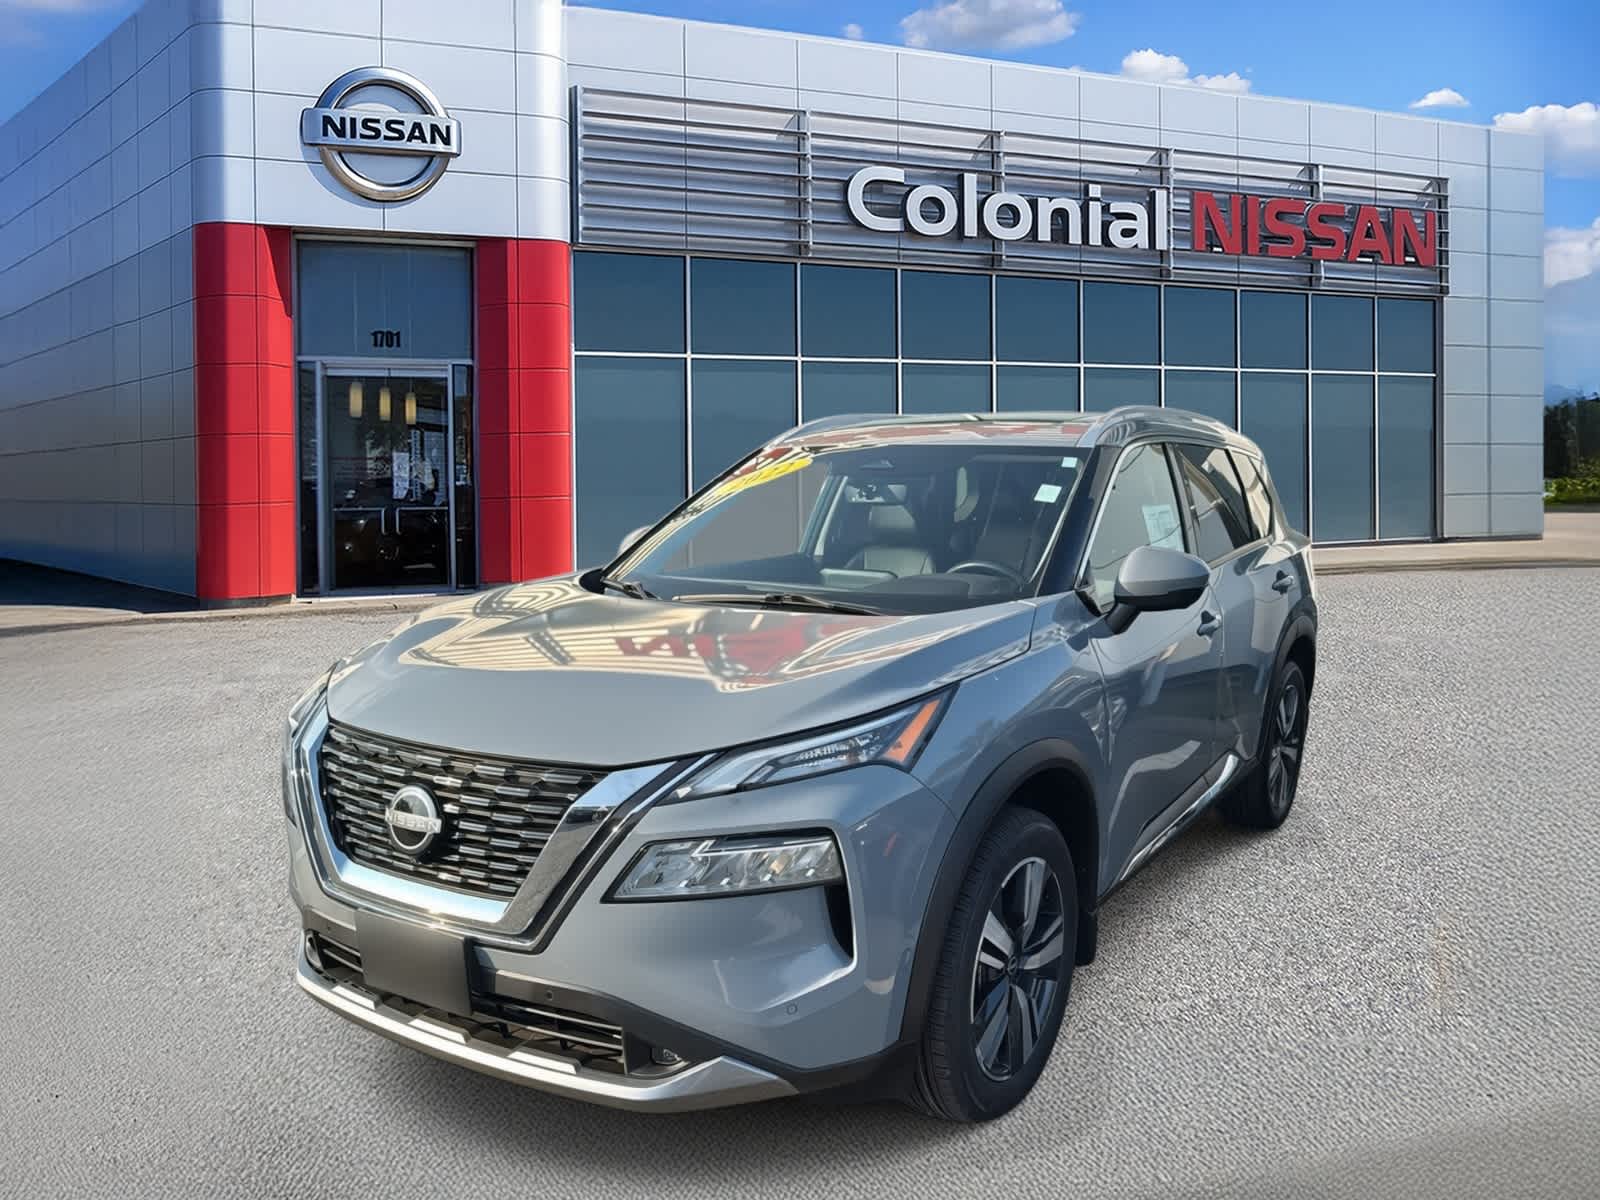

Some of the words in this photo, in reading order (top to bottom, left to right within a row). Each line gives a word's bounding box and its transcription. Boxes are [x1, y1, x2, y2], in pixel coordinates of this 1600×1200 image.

[322, 116, 451, 146] NISSAN
[847, 165, 1168, 250] Colonial
[1191, 190, 1436, 267] NISSAN
[370, 330, 401, 348] 1701
